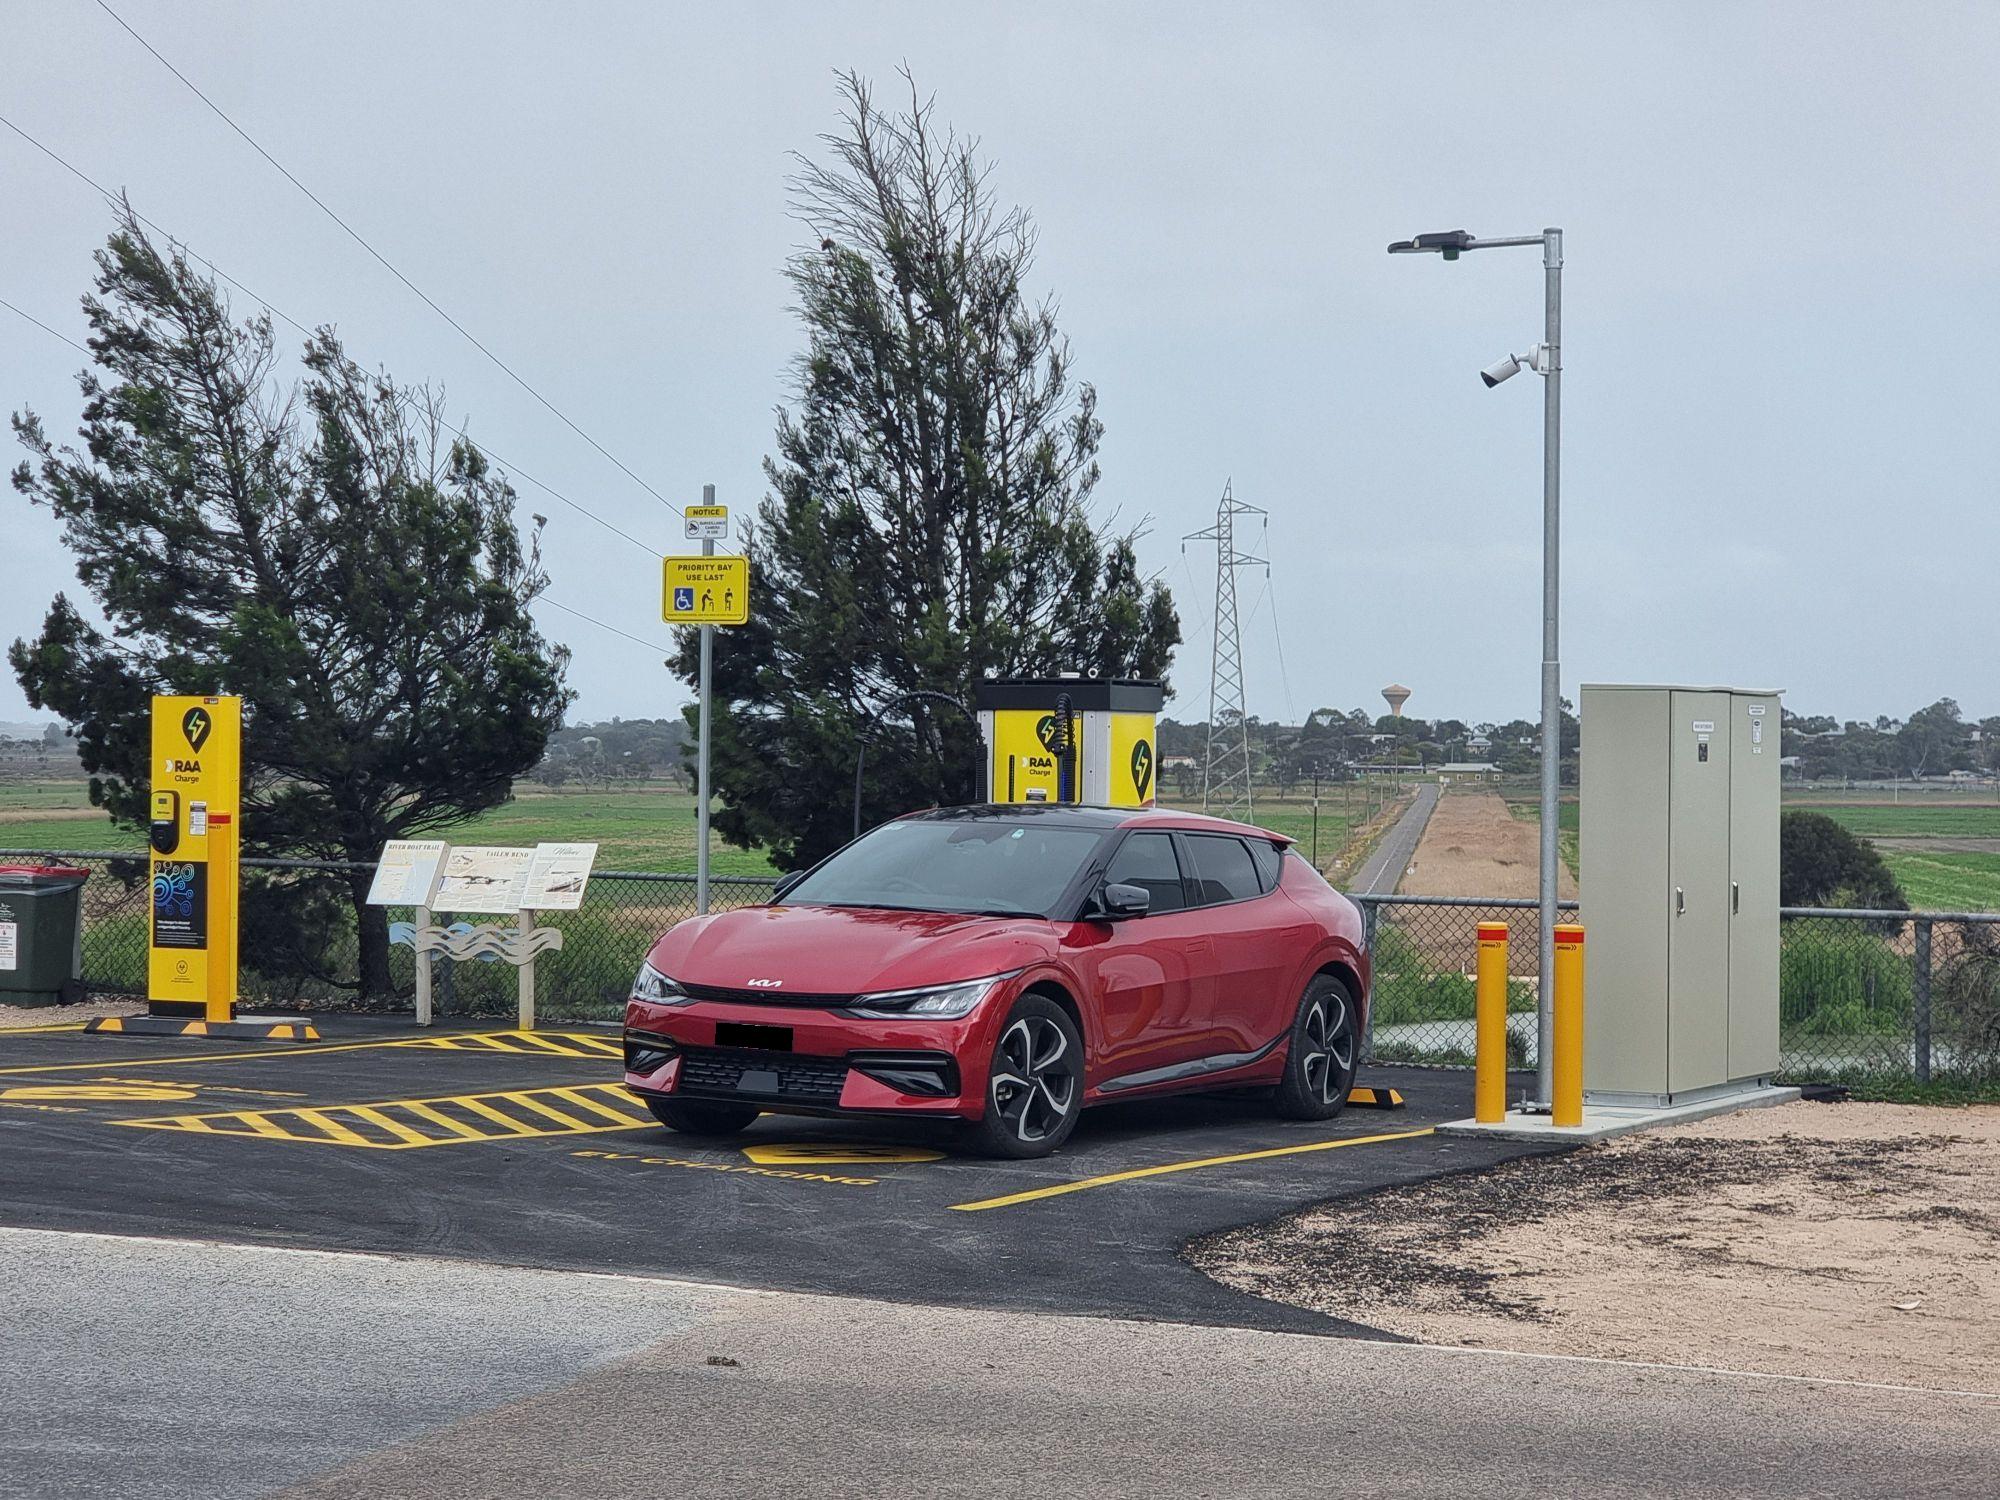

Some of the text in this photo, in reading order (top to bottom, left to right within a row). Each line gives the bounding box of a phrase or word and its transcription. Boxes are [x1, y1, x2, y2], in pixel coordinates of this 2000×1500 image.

[174, 760, 201, 772] RAA
[1029, 757, 1052, 767] RAA
[174, 775, 199, 784] Charge
[639, 1158, 881, 1186] CHARGING
